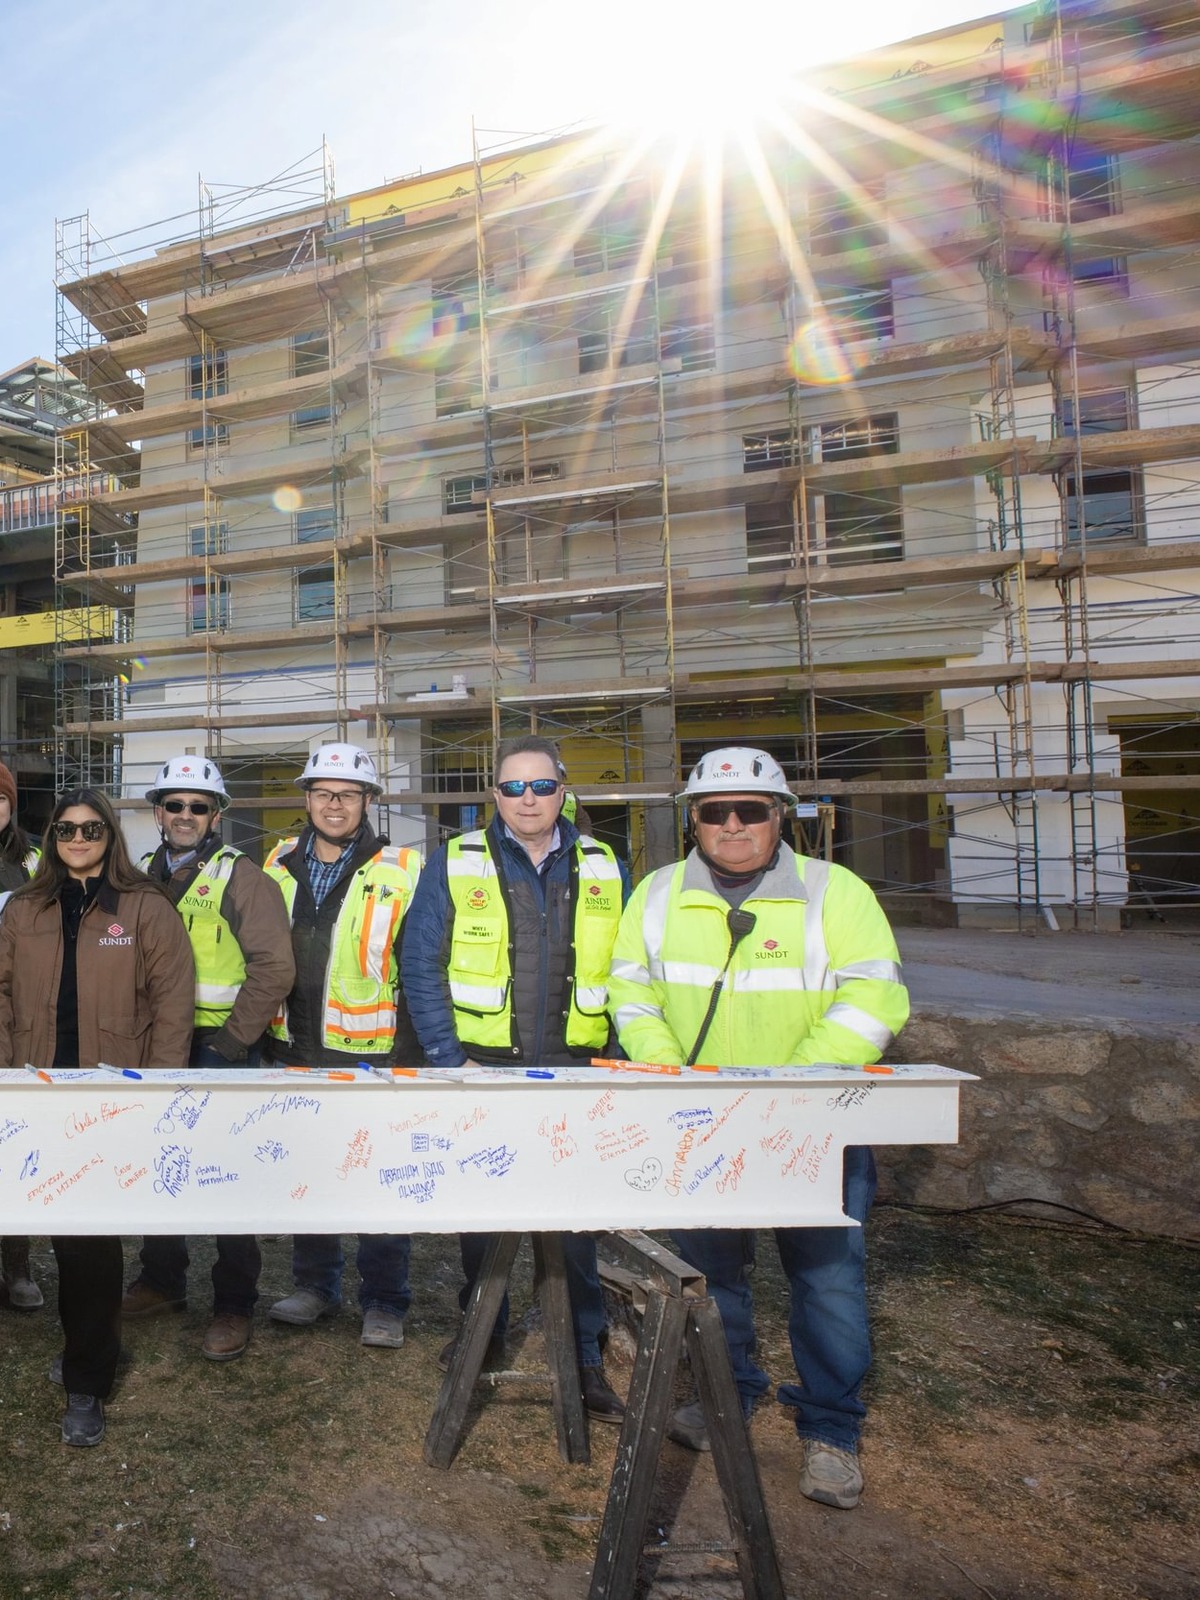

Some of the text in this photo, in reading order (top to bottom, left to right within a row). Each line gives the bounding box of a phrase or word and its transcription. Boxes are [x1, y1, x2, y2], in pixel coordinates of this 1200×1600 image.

[183, 895, 215, 910] SUNDT
[99, 936, 133, 946] SUNDT
[755, 951, 789, 960] SUNDT
